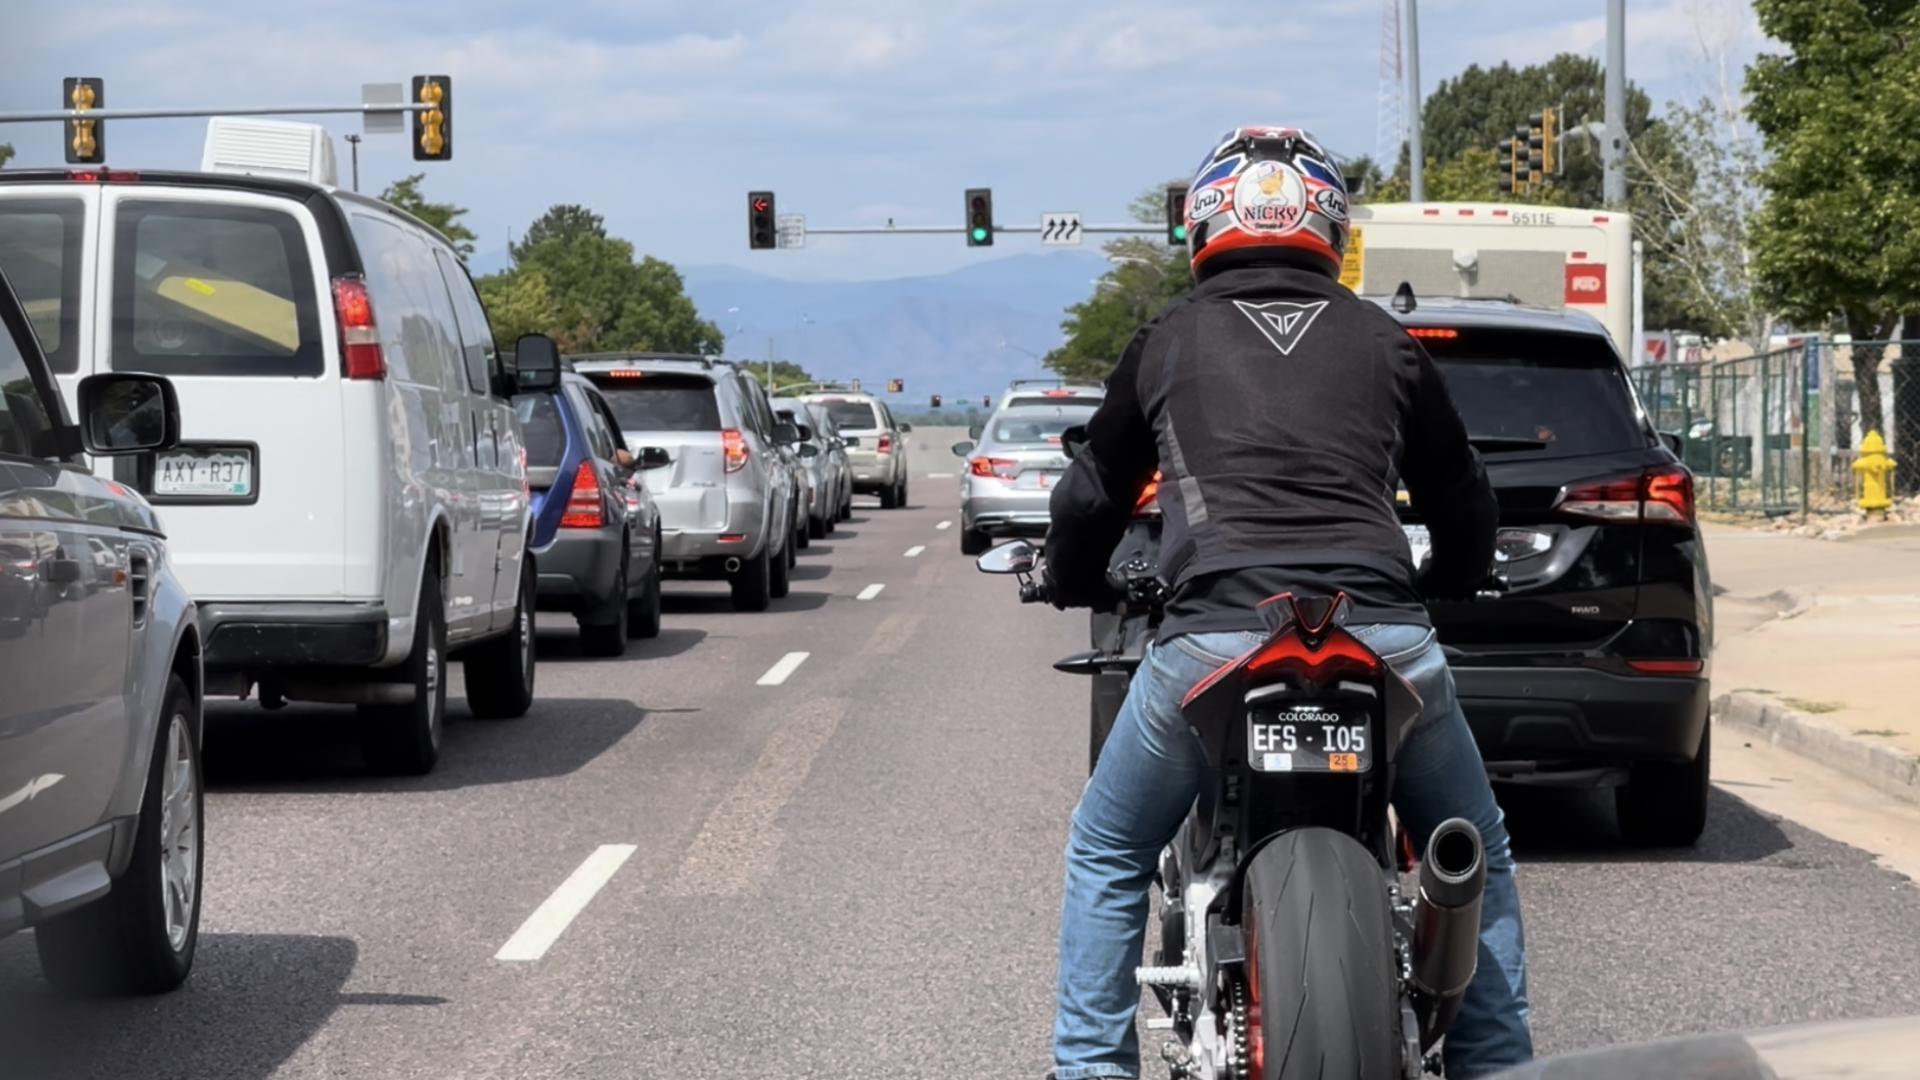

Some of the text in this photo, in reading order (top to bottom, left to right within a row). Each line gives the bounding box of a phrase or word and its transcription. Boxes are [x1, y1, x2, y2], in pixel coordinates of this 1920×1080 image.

[1244, 205, 1297, 220] NICKY
[1512, 212, 1555, 225] 6511E
[1278, 712, 1339, 722] COLORADO
